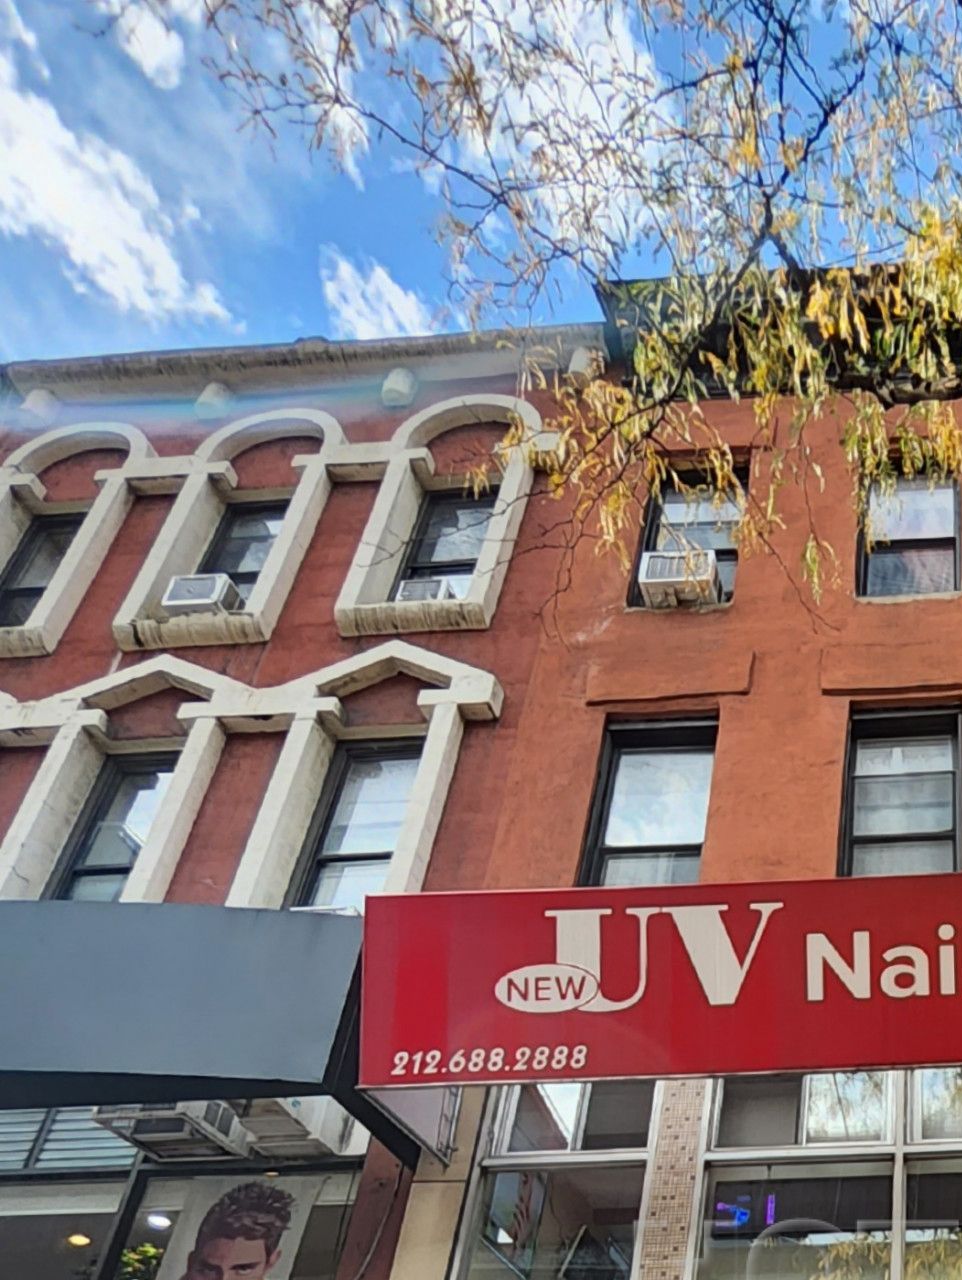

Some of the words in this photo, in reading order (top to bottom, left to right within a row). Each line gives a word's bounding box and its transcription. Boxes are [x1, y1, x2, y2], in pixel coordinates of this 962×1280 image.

[545, 901, 784, 1013] UV
[506, 975, 587, 1001] NEW
[390, 1045, 588, 1076] 212.688.2888
